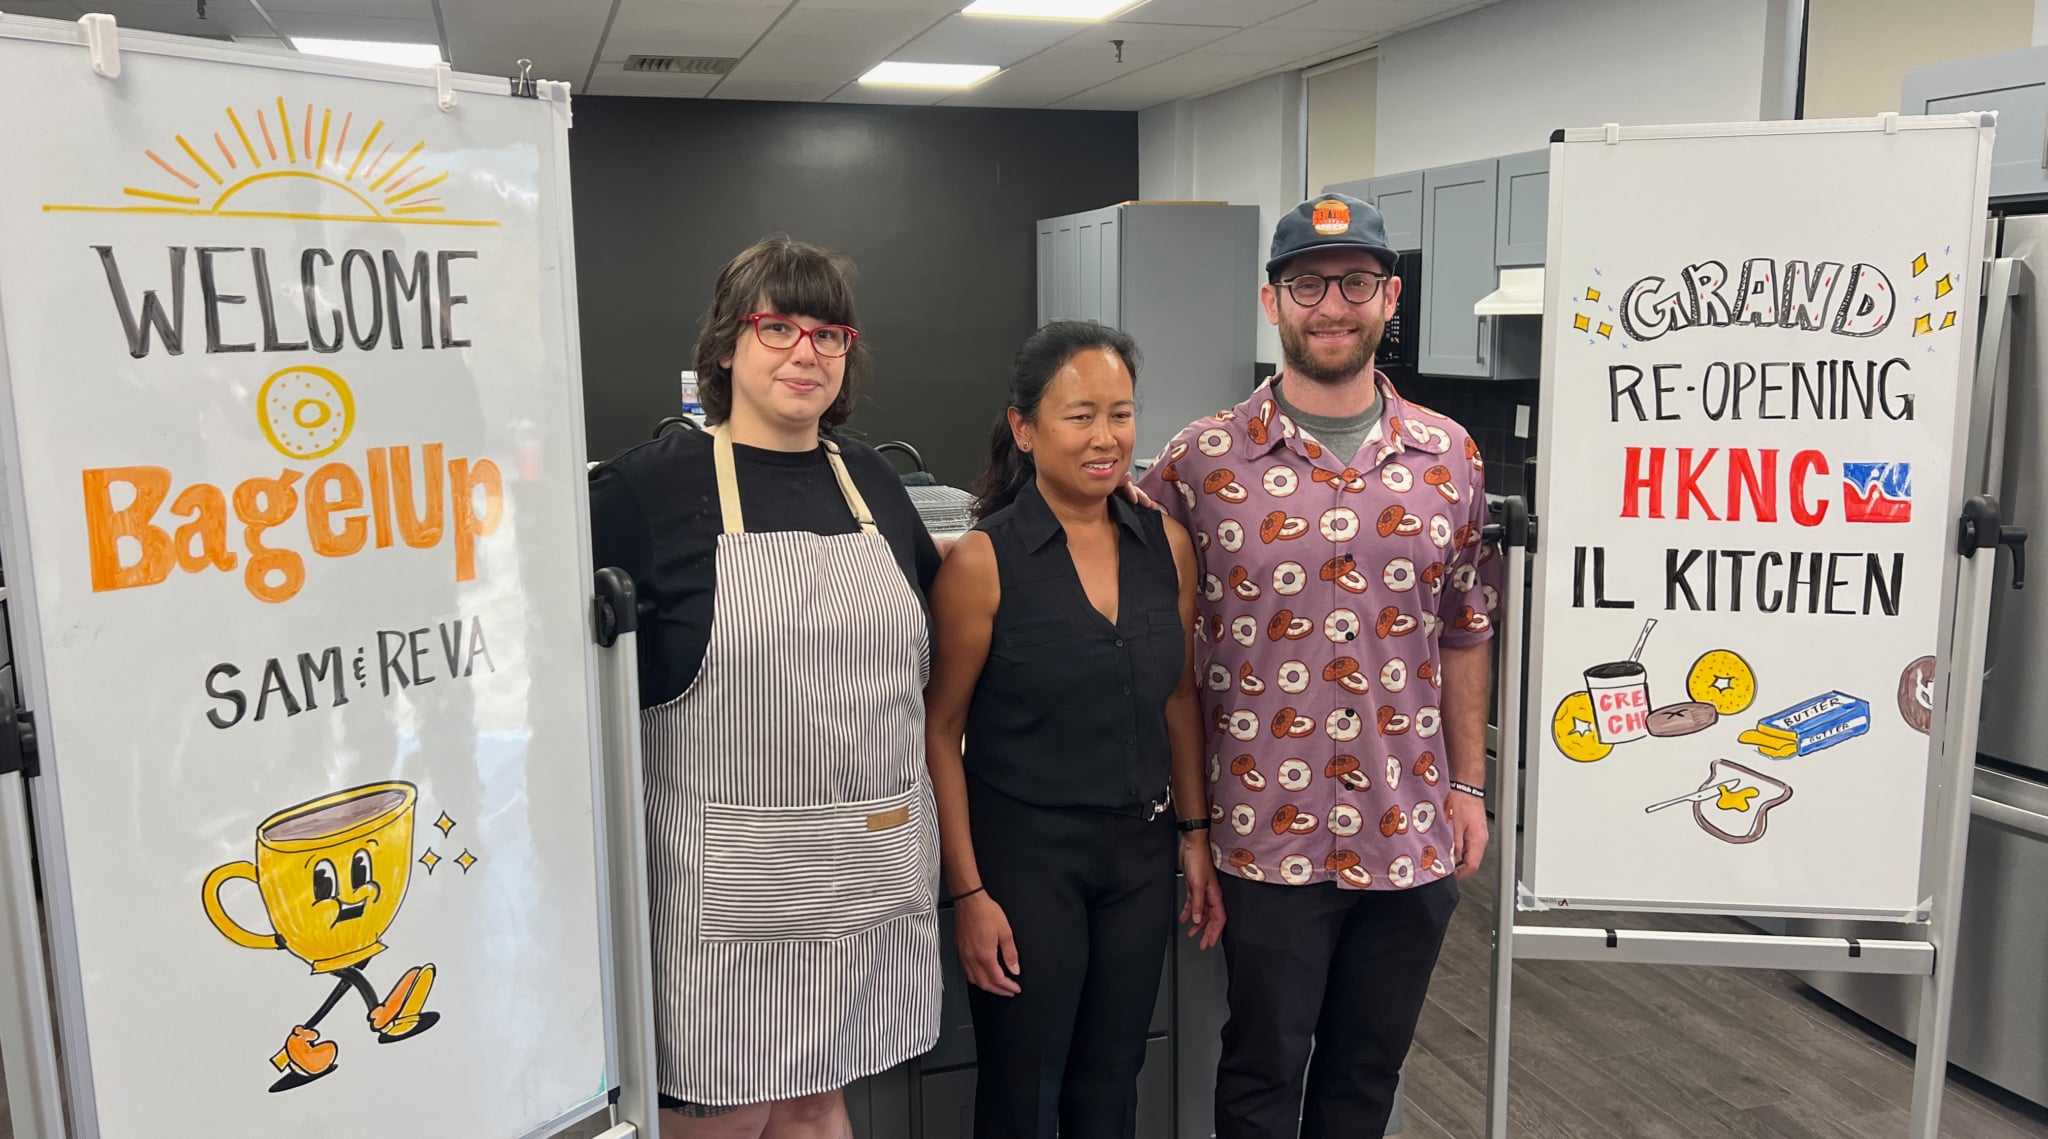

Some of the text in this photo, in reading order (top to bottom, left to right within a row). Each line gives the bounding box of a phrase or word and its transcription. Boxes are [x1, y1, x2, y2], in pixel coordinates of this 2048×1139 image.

[90, 246, 478, 359] WELCOME
[1619, 257, 1897, 342] GRAND
[1608, 357, 1915, 423] RE-OPENING
[82, 442, 503, 604] BagelUp
[1619, 446, 1831, 528] HKNC
[1572, 546, 1905, 617] IL KITCHEN
[205, 645, 350, 730] SAM
[376, 615, 496, 698] REVA
[1600, 689, 1647, 712] CRE
[1783, 697, 1844, 728] BUTTER
